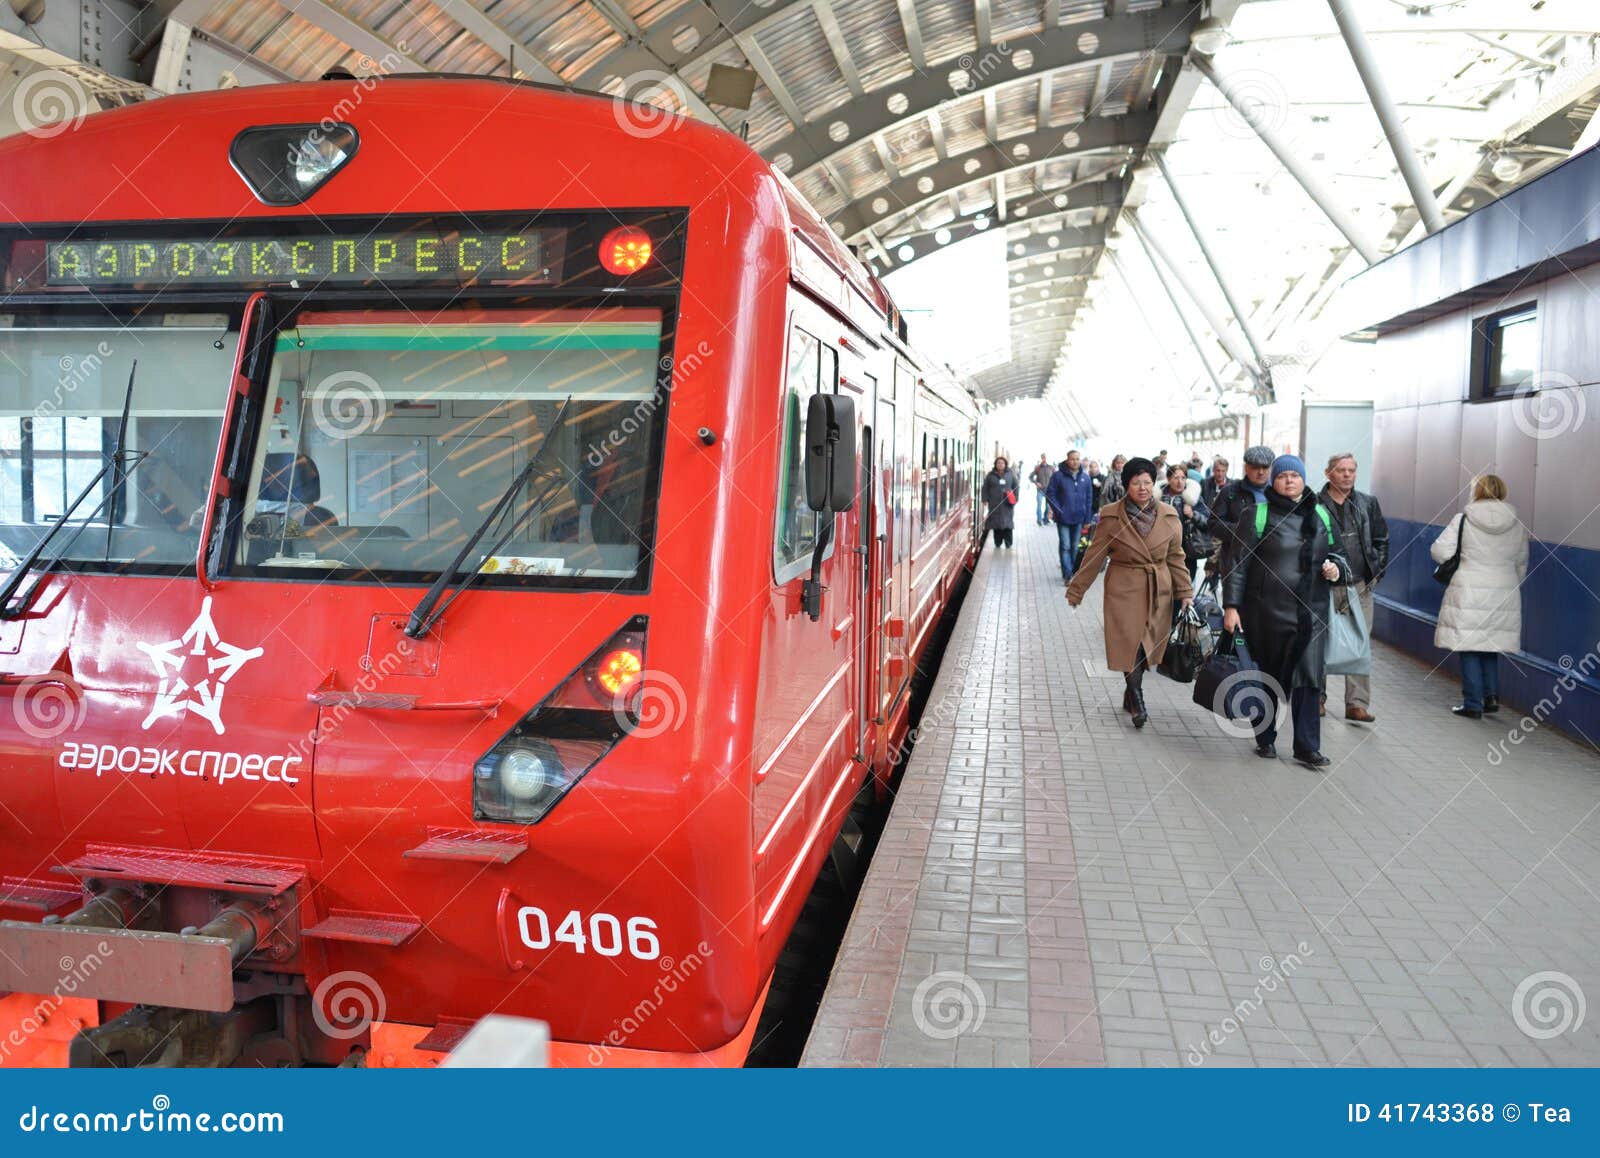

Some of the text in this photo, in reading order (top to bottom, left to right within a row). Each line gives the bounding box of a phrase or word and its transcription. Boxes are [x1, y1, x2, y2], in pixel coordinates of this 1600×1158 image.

[59, 236, 527, 278] АЭРОЭКСПРЕСС
[58, 742, 302, 784] аэроэкспресс
[518, 906, 660, 960] 0406
